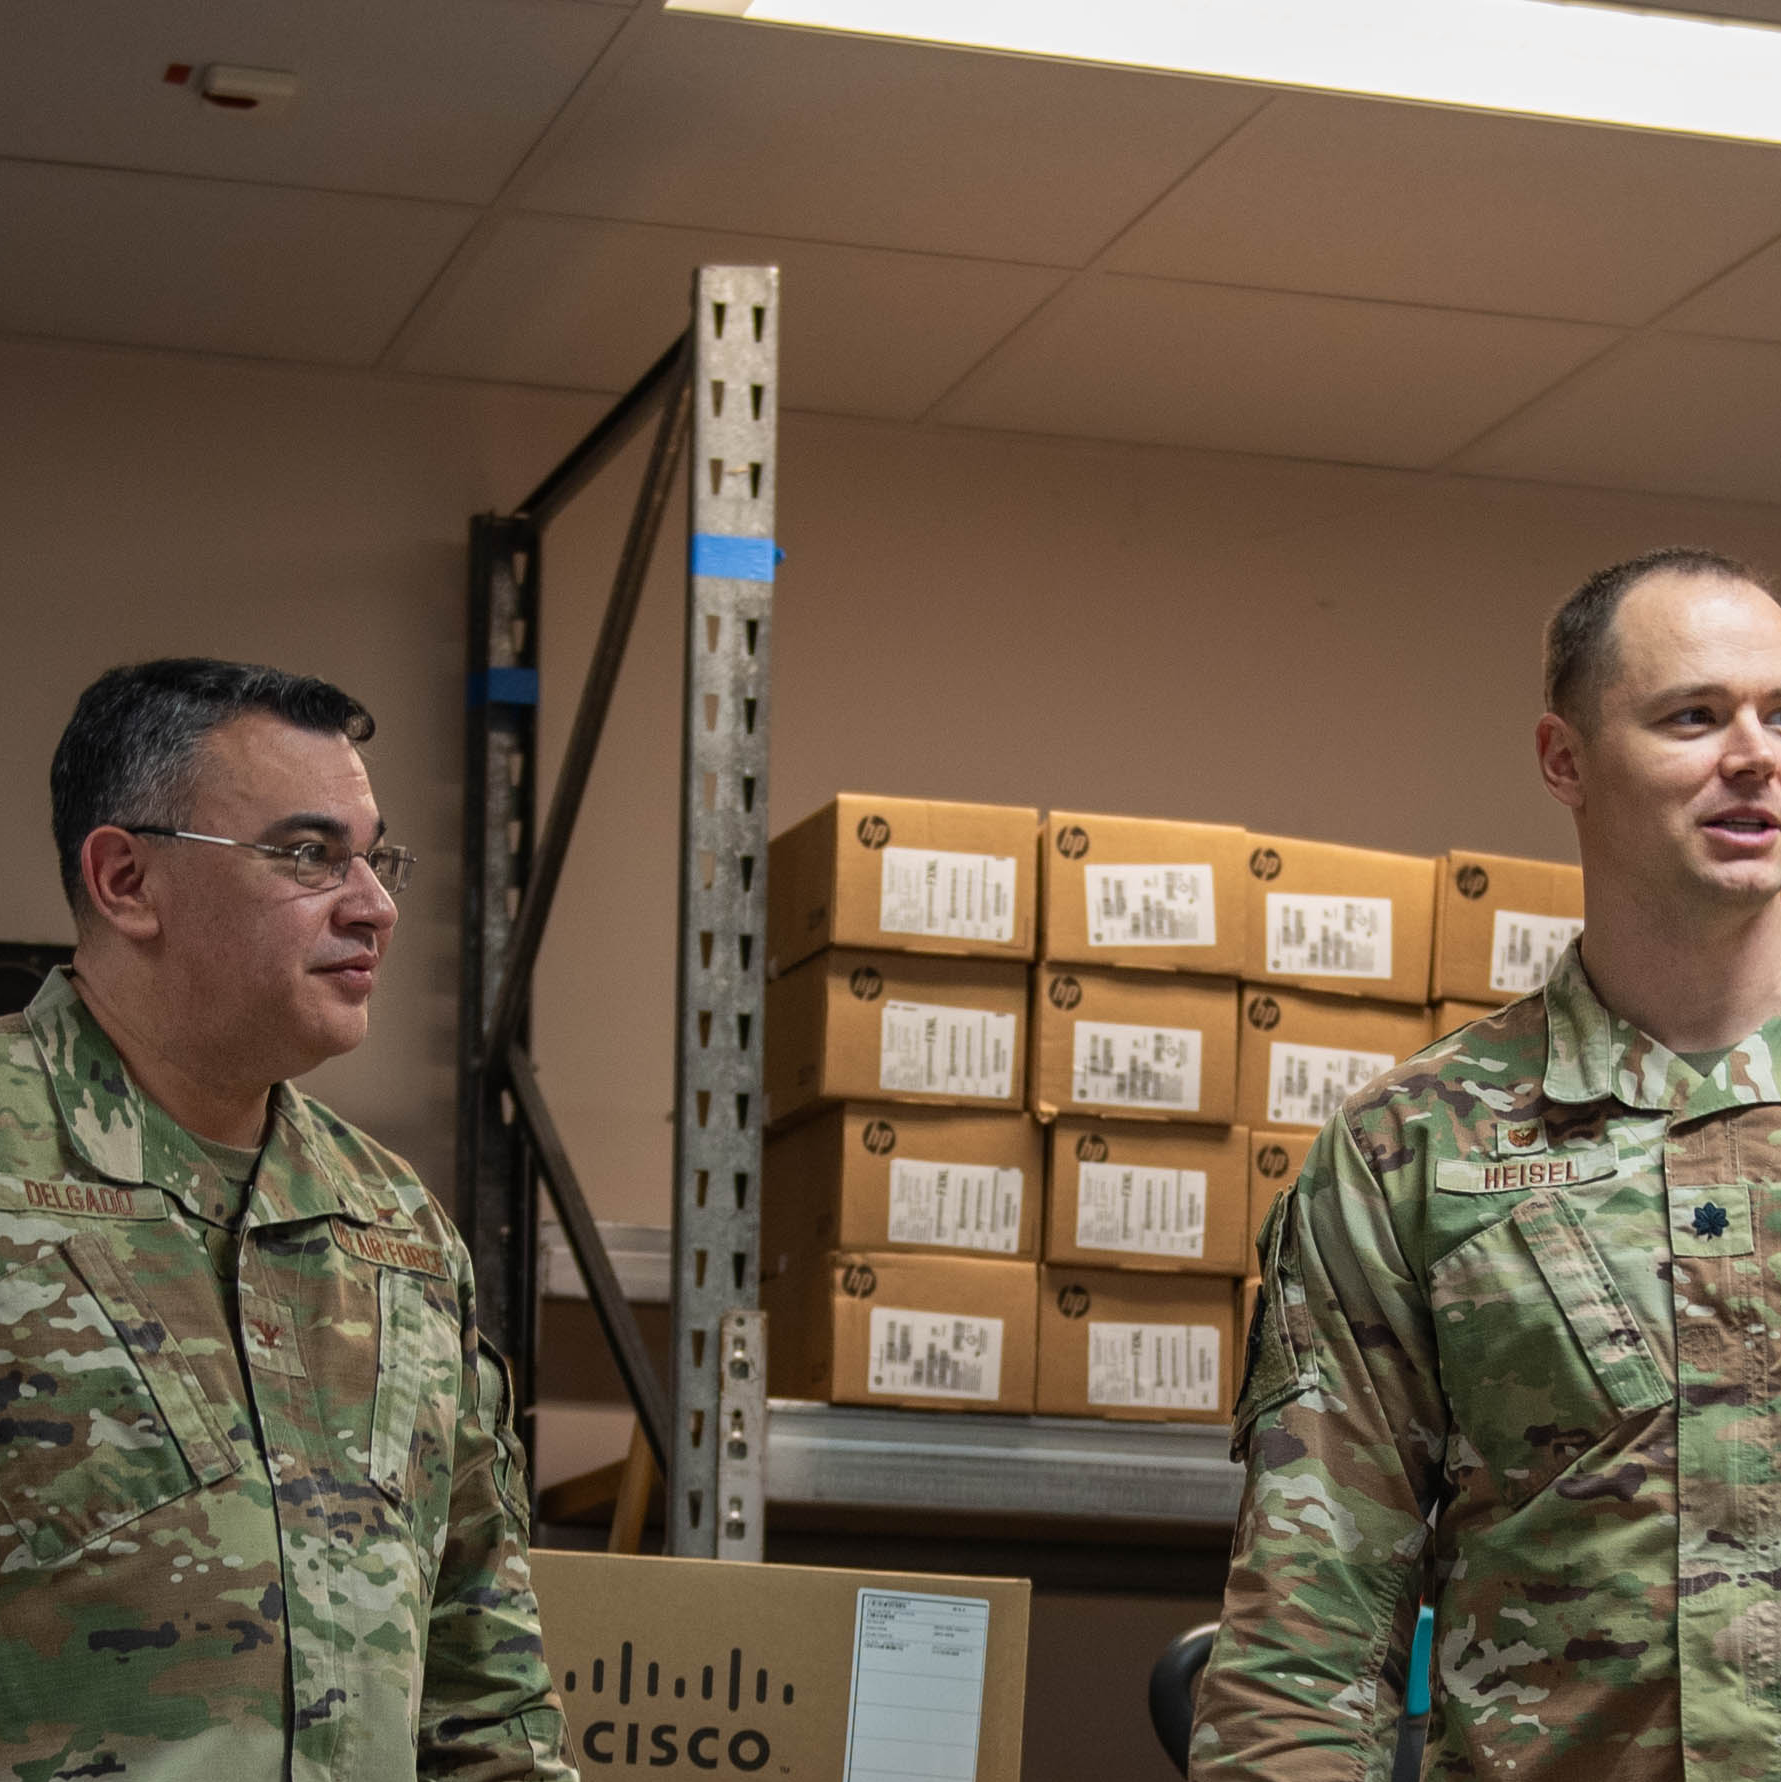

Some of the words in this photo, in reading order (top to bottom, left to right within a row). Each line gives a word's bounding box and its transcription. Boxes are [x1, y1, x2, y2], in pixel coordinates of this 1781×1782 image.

[1484, 1158, 1580, 1190] HEISEL
[26, 1180, 137, 1216] DELGADO
[356, 1232, 388, 1262] AIR
[387, 1240, 445, 1276] FORCE
[582, 1720, 771, 1772] CISCO
